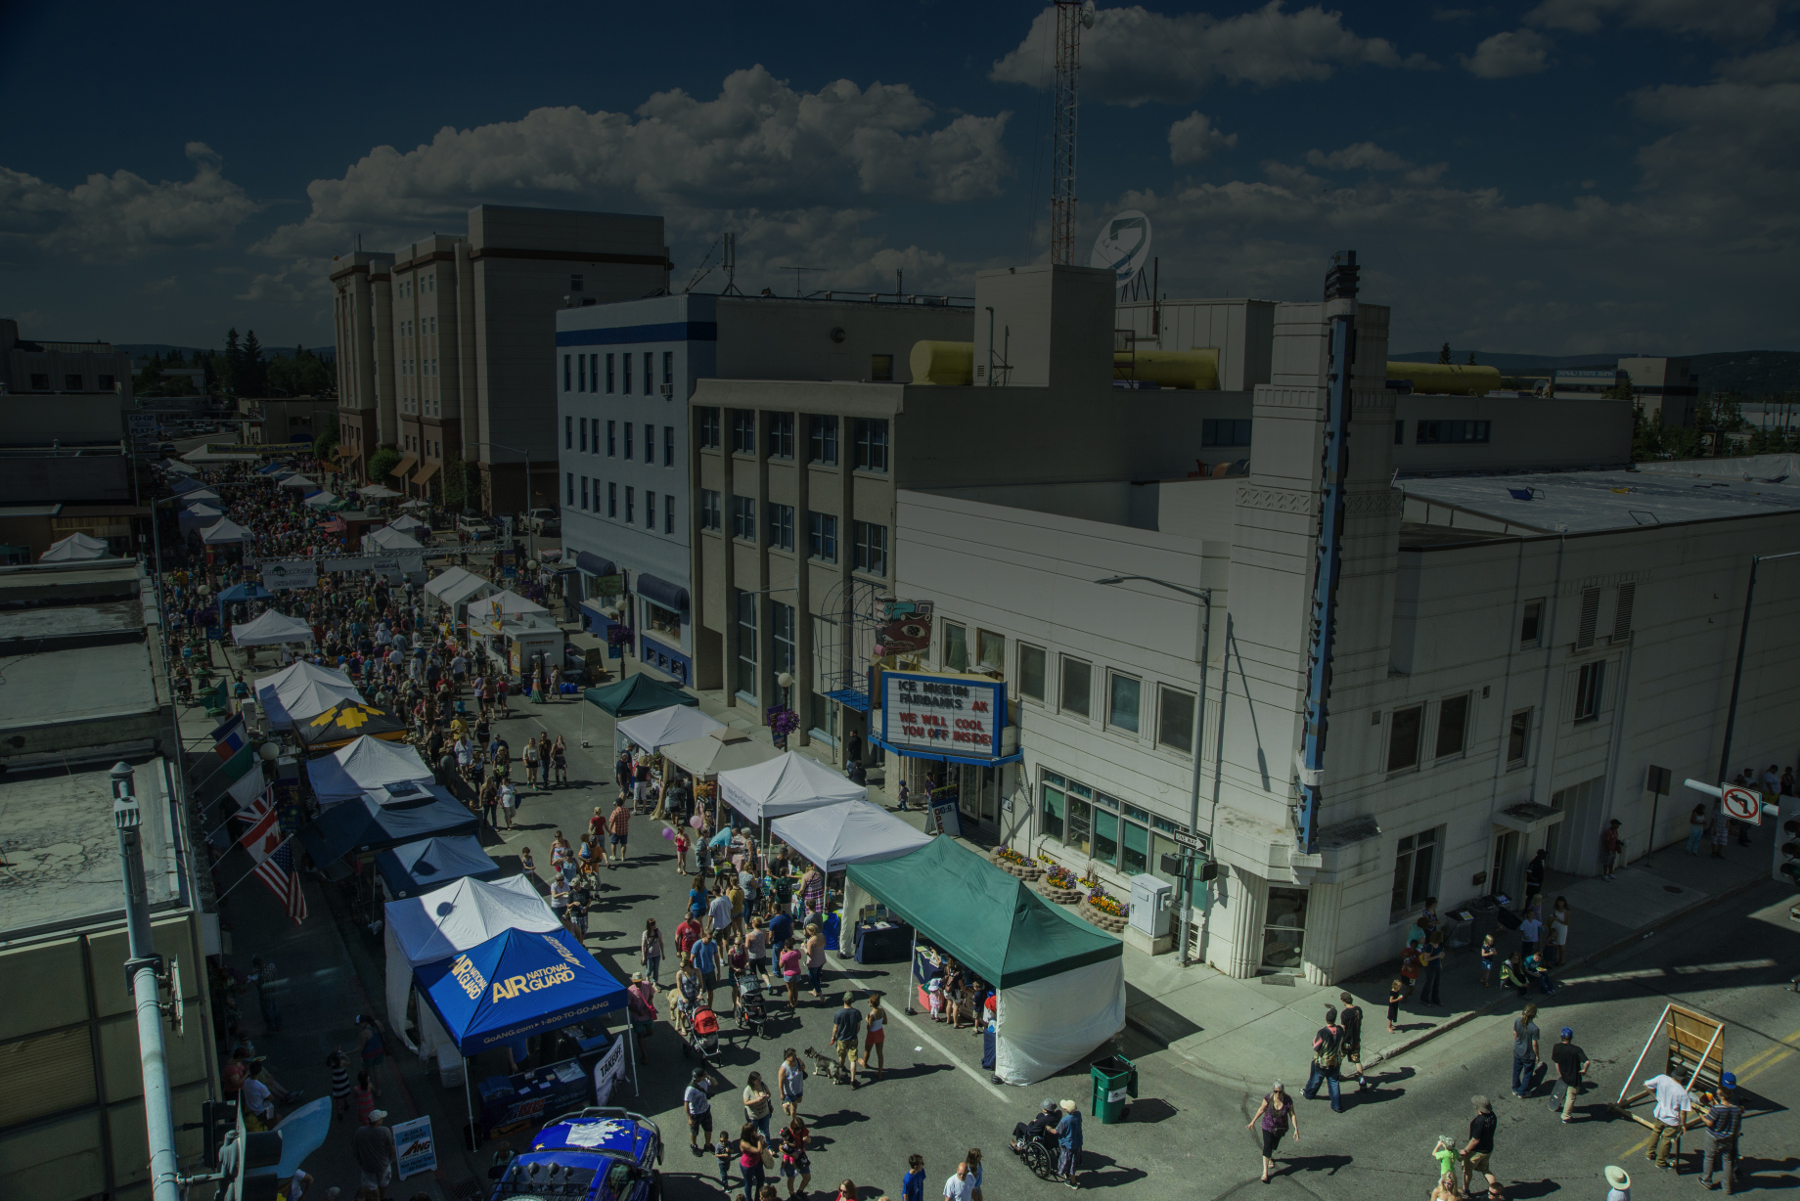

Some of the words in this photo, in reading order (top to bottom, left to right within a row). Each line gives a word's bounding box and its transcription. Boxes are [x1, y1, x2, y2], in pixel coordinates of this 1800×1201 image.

[898, 680, 917, 692] ICE
[923, 683, 969, 698] MUSEUM
[900, 693, 963, 709] FAIRBANKS
[972, 701, 988, 713] AK
[899, 712, 917, 724] WE
[921, 714, 947, 727] WILL
[955, 718, 984, 731] COOL
[902, 725, 924, 738] YOU
[927, 728, 948, 740] OFF
[953, 730, 992, 745] INSIDE!
[1177, 833, 1186, 842] ONE
[448, 954, 473, 981] AIR
[469, 966, 488, 991] NATIONAL
[526, 963, 570, 981] NATIONAL
[459, 973, 482, 1001] GUARD
[493, 975, 531, 1004] AIR
[529, 970, 575, 992] GUARD
[484, 1025, 534, 1044] GoANG.com
[541, 1000, 609, 1027] 1-800-TO-GO-ANG
[400, 1140, 431, 1158] ANG
